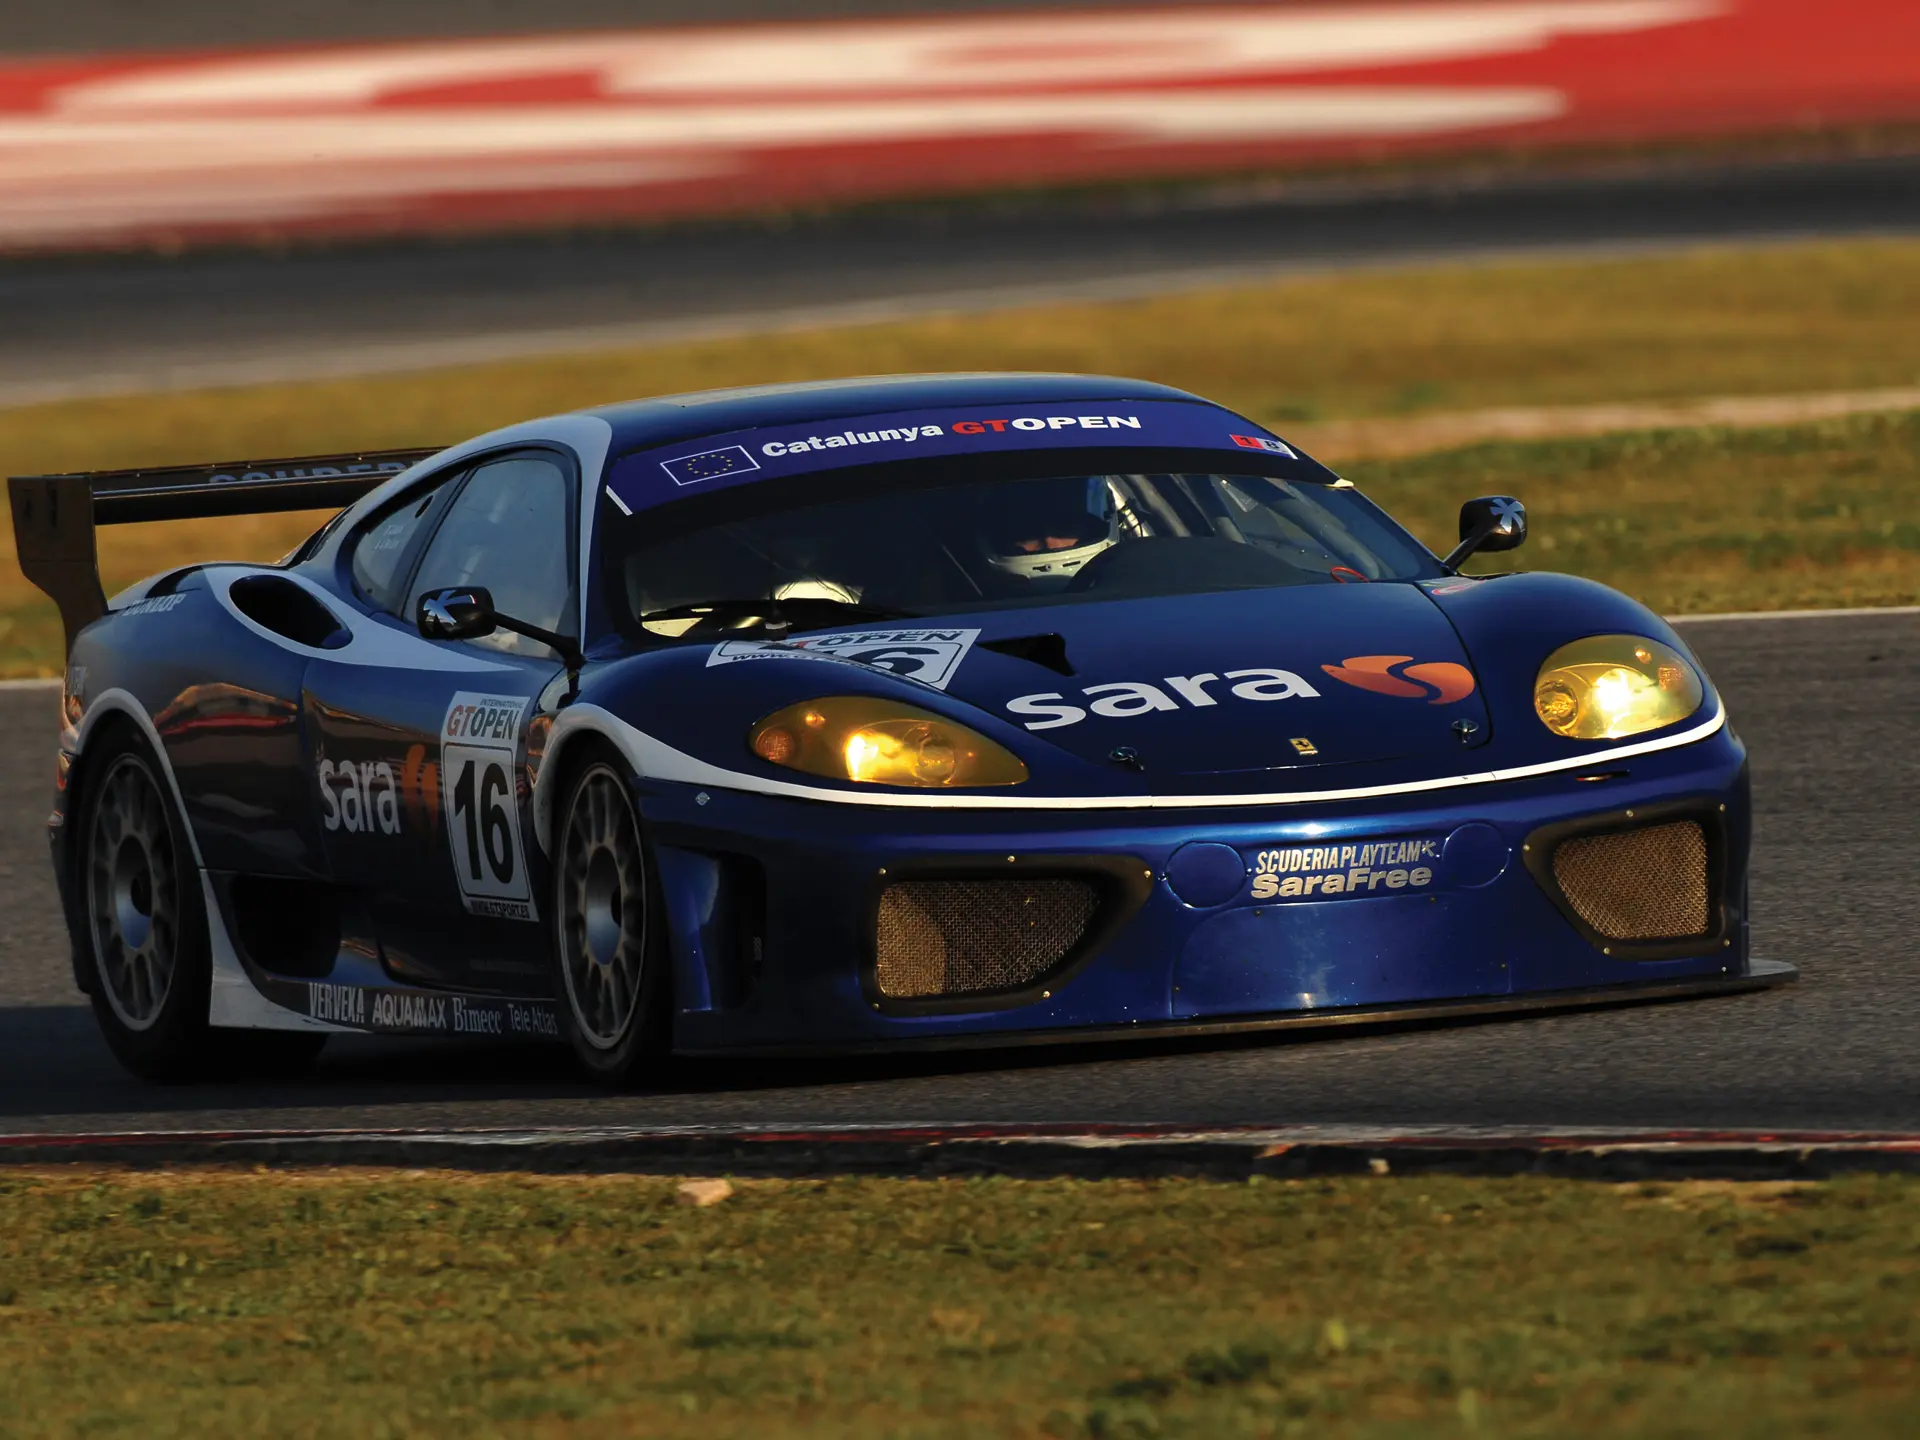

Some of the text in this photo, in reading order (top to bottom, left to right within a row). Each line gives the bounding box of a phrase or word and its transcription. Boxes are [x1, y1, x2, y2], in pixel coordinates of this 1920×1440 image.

[762, 416, 1141, 457] Catalunya GTOPEN
[121, 593, 188, 617] DUNLOP
[1006, 668, 1321, 731] sara
[447, 704, 519, 740] GTOPEN
[320, 759, 402, 836] sara
[454, 760, 514, 884] 16
[1250, 867, 1432, 899] SaraFree
[507, 1003, 531, 1032] Tele
[531, 1005, 558, 1035] Atlas
